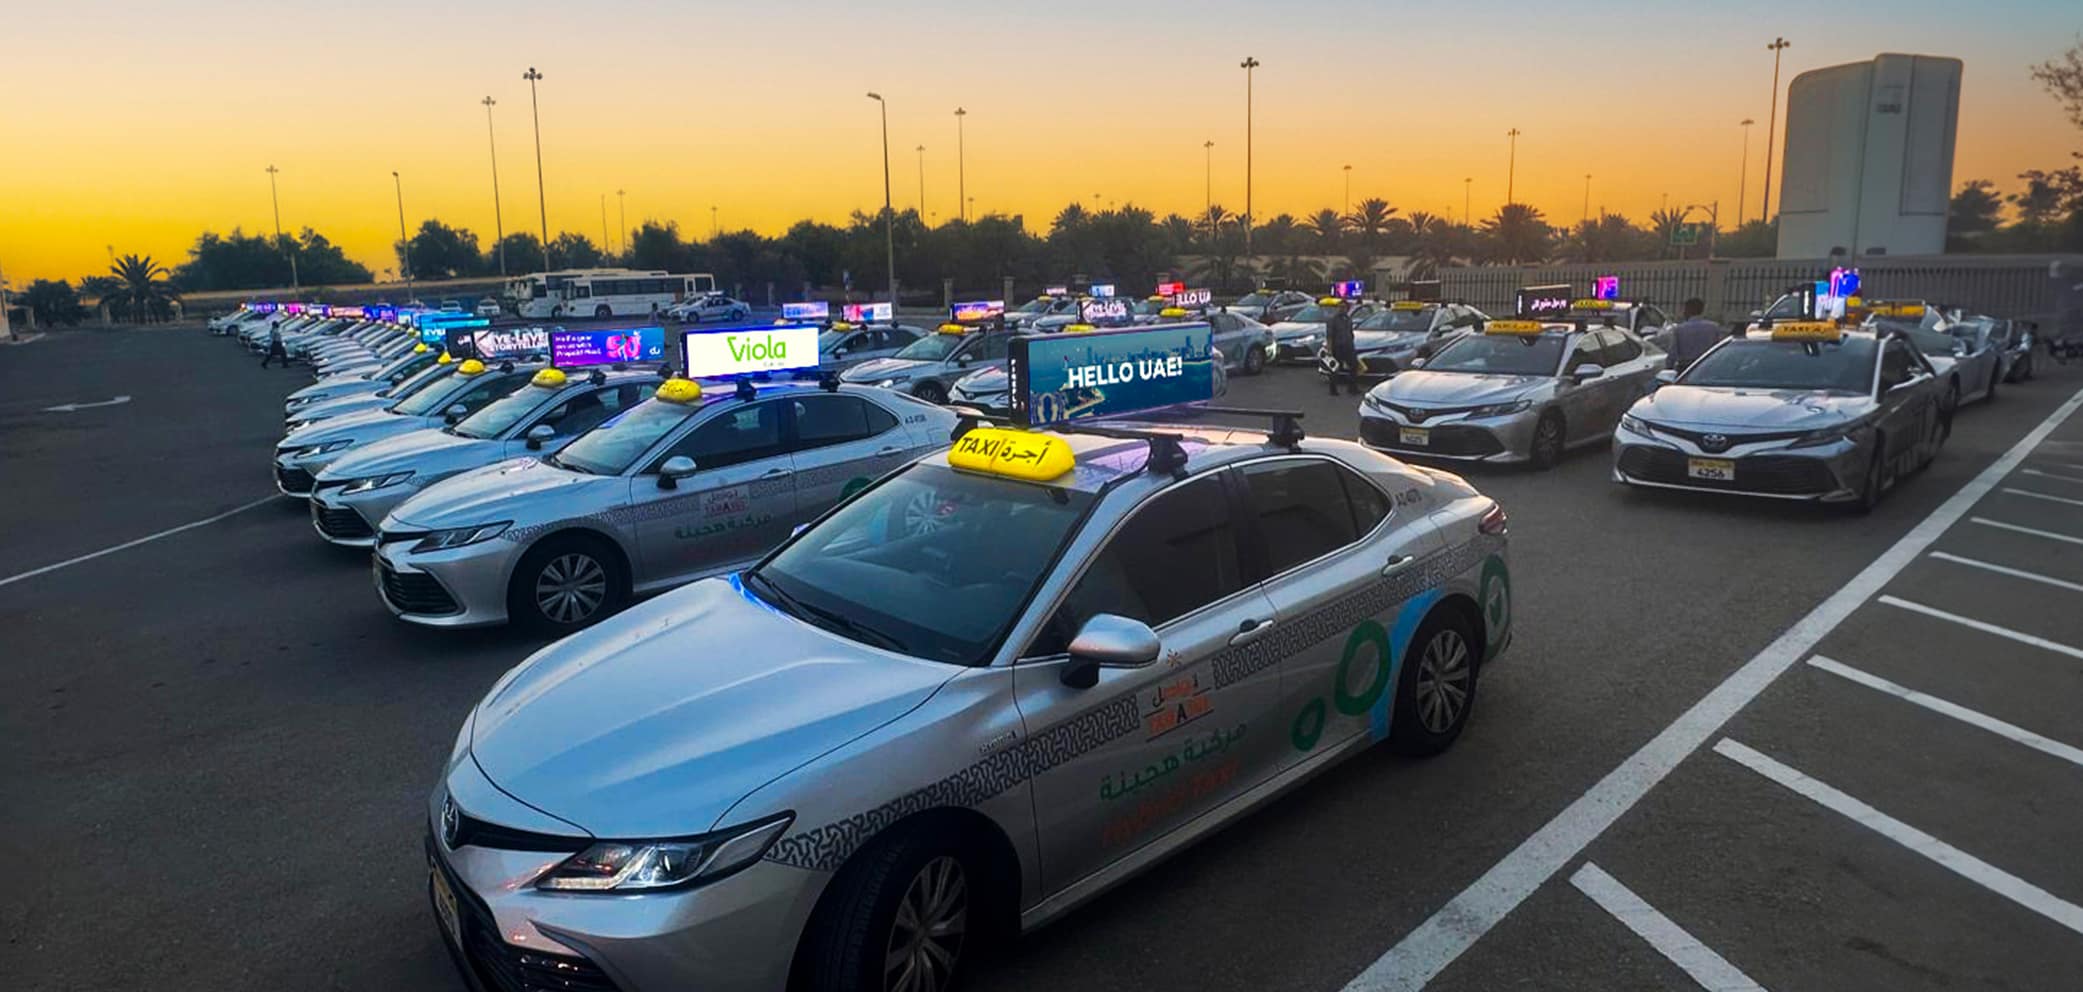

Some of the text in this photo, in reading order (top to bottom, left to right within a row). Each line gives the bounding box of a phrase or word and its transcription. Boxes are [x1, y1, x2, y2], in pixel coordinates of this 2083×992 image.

[727, 335, 787, 362] Viola
[1068, 356, 1183, 389] HELLO UAE!
[958, 437, 1000, 457] TAXI
[1001, 440, 1052, 465] أجرة
